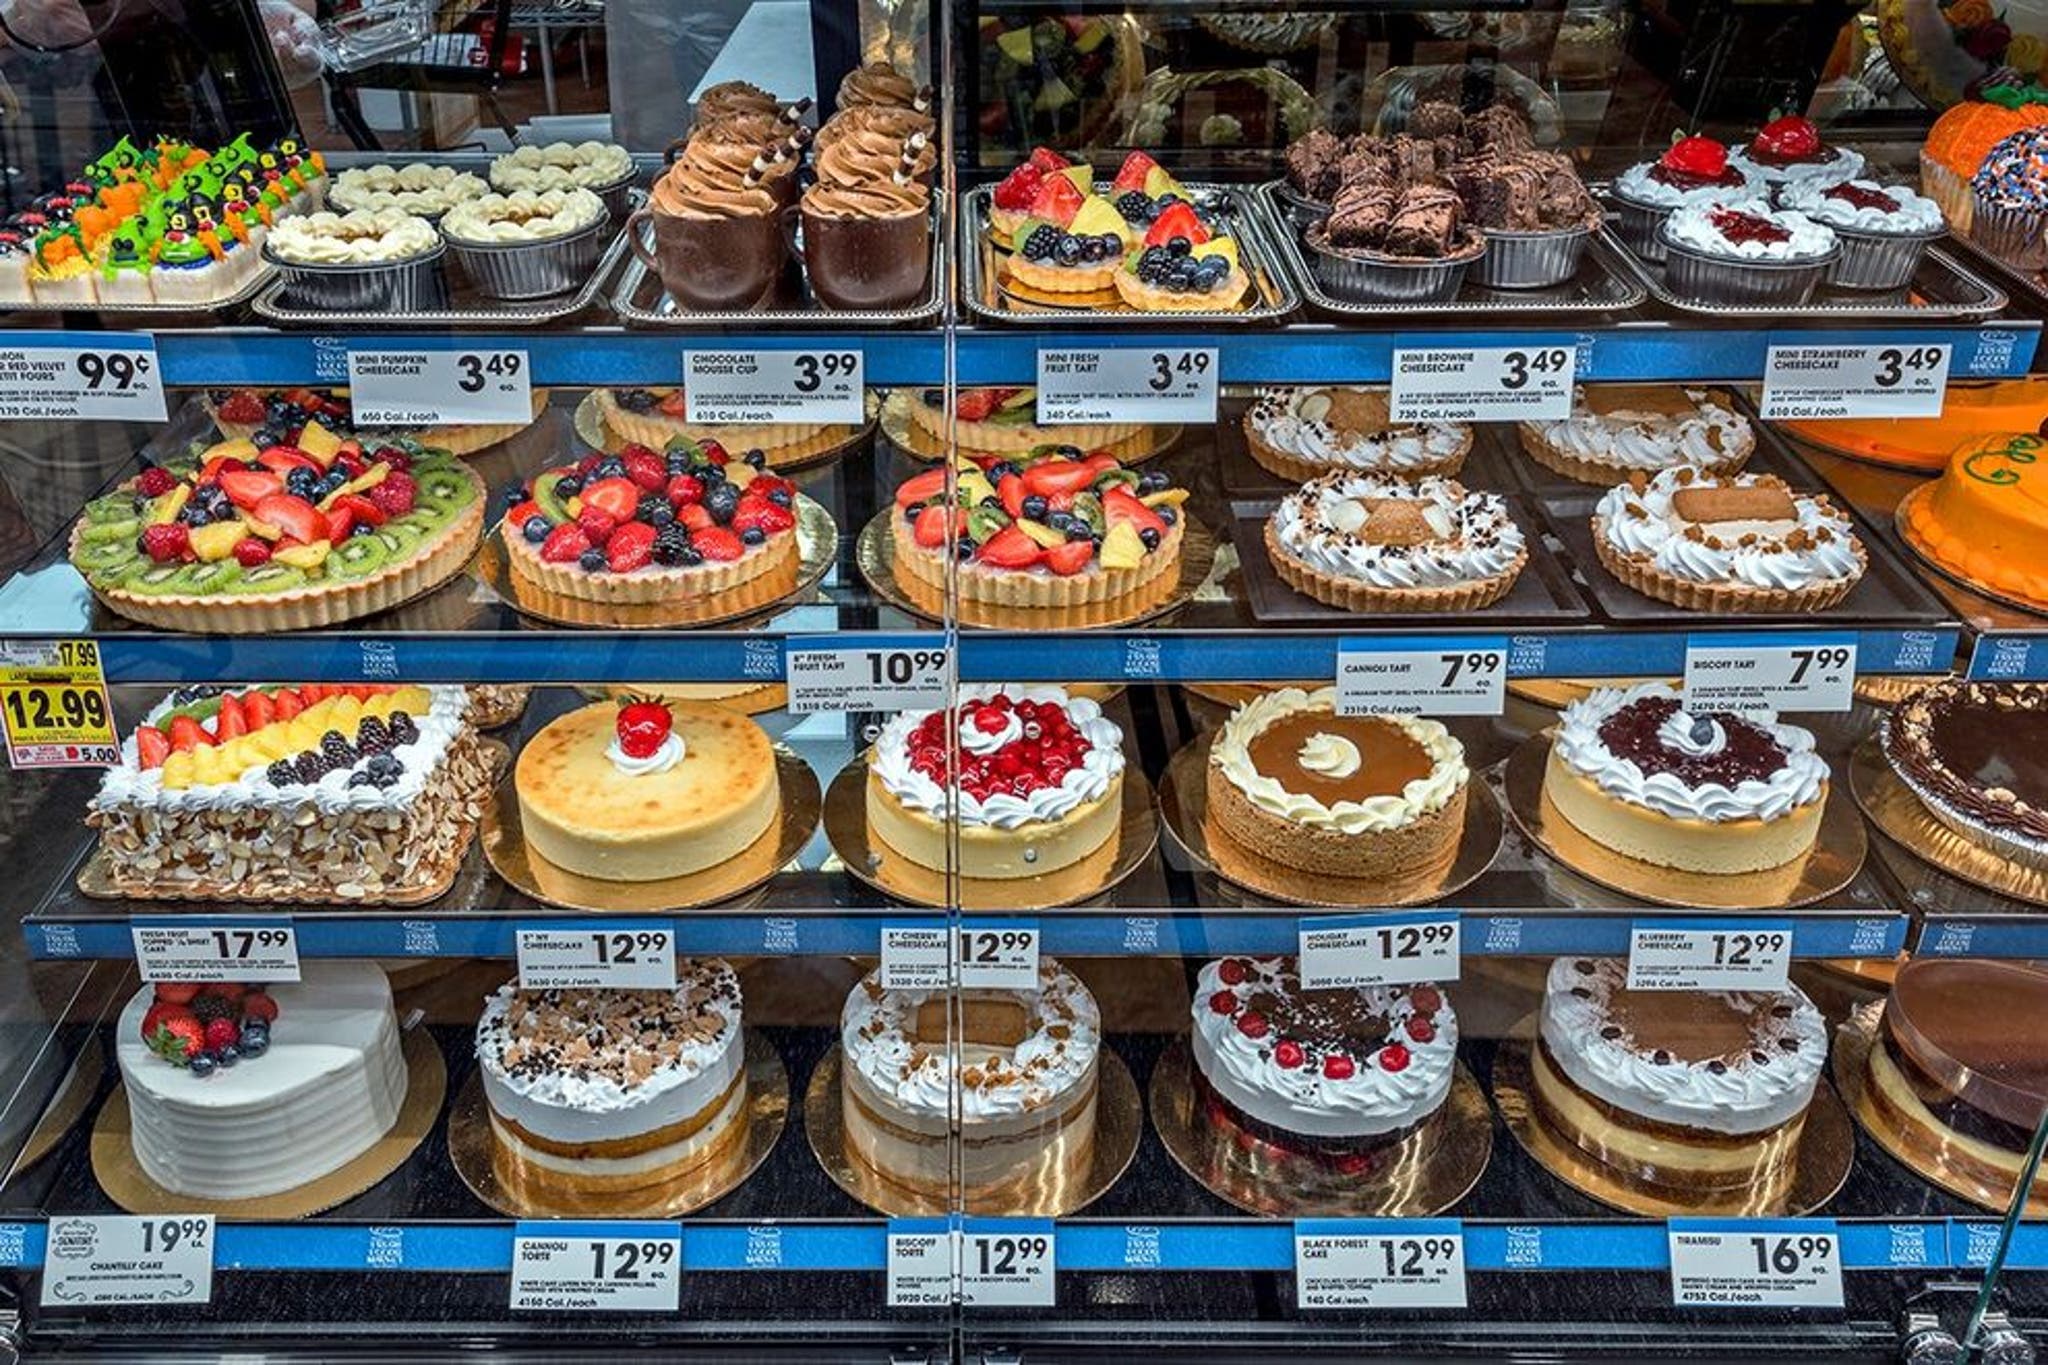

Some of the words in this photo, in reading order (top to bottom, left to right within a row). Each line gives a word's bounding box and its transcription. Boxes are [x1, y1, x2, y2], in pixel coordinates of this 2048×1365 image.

[1045, 354, 1067, 362] MINI
[1070, 354, 1099, 362] FRESH
[1400, 353, 1425, 362] MINI
[1427, 353, 1474, 362] BROWNIE
[1774, 350, 1800, 359] MINI
[1802, 350, 1867, 359] STRAWBERRY
[356, 355, 382, 364] MINI
[384, 355, 428, 364] PUMPKIN
[693, 355, 756, 364] CHOCOLATE
[30, 362, 65, 370] VELVET
[693, 365, 734, 374] MOUSSE
[736, 365, 758, 374] CUP
[1045, 364, 1070, 373] FRUIT
[1074, 364, 1098, 373] TART
[1400, 364, 1465, 373] CHEESECAKE
[1774, 361, 1839, 370] CHEESECAKE
[356, 366, 420, 375] CHEESECAKE
[822, 663, 845, 671] TART
[1390, 664, 1412, 672] TART
[7, 689, 106, 729] 12.99
[81, 748, 117, 762] 5.00
[523, 942, 583, 951] CHEESECAKE
[1303, 1240, 1332, 1248] BLACK
[1334, 1240, 1369, 1248] FOREST
[522, 1252, 551, 1260] TORTE
[896, 1248, 924, 1257] TORTE
[1303, 1250, 1328, 1258] CAKE
[90, 1262, 138, 1271] CHANTILLY
[139, 1261, 164, 1270] CAKE
